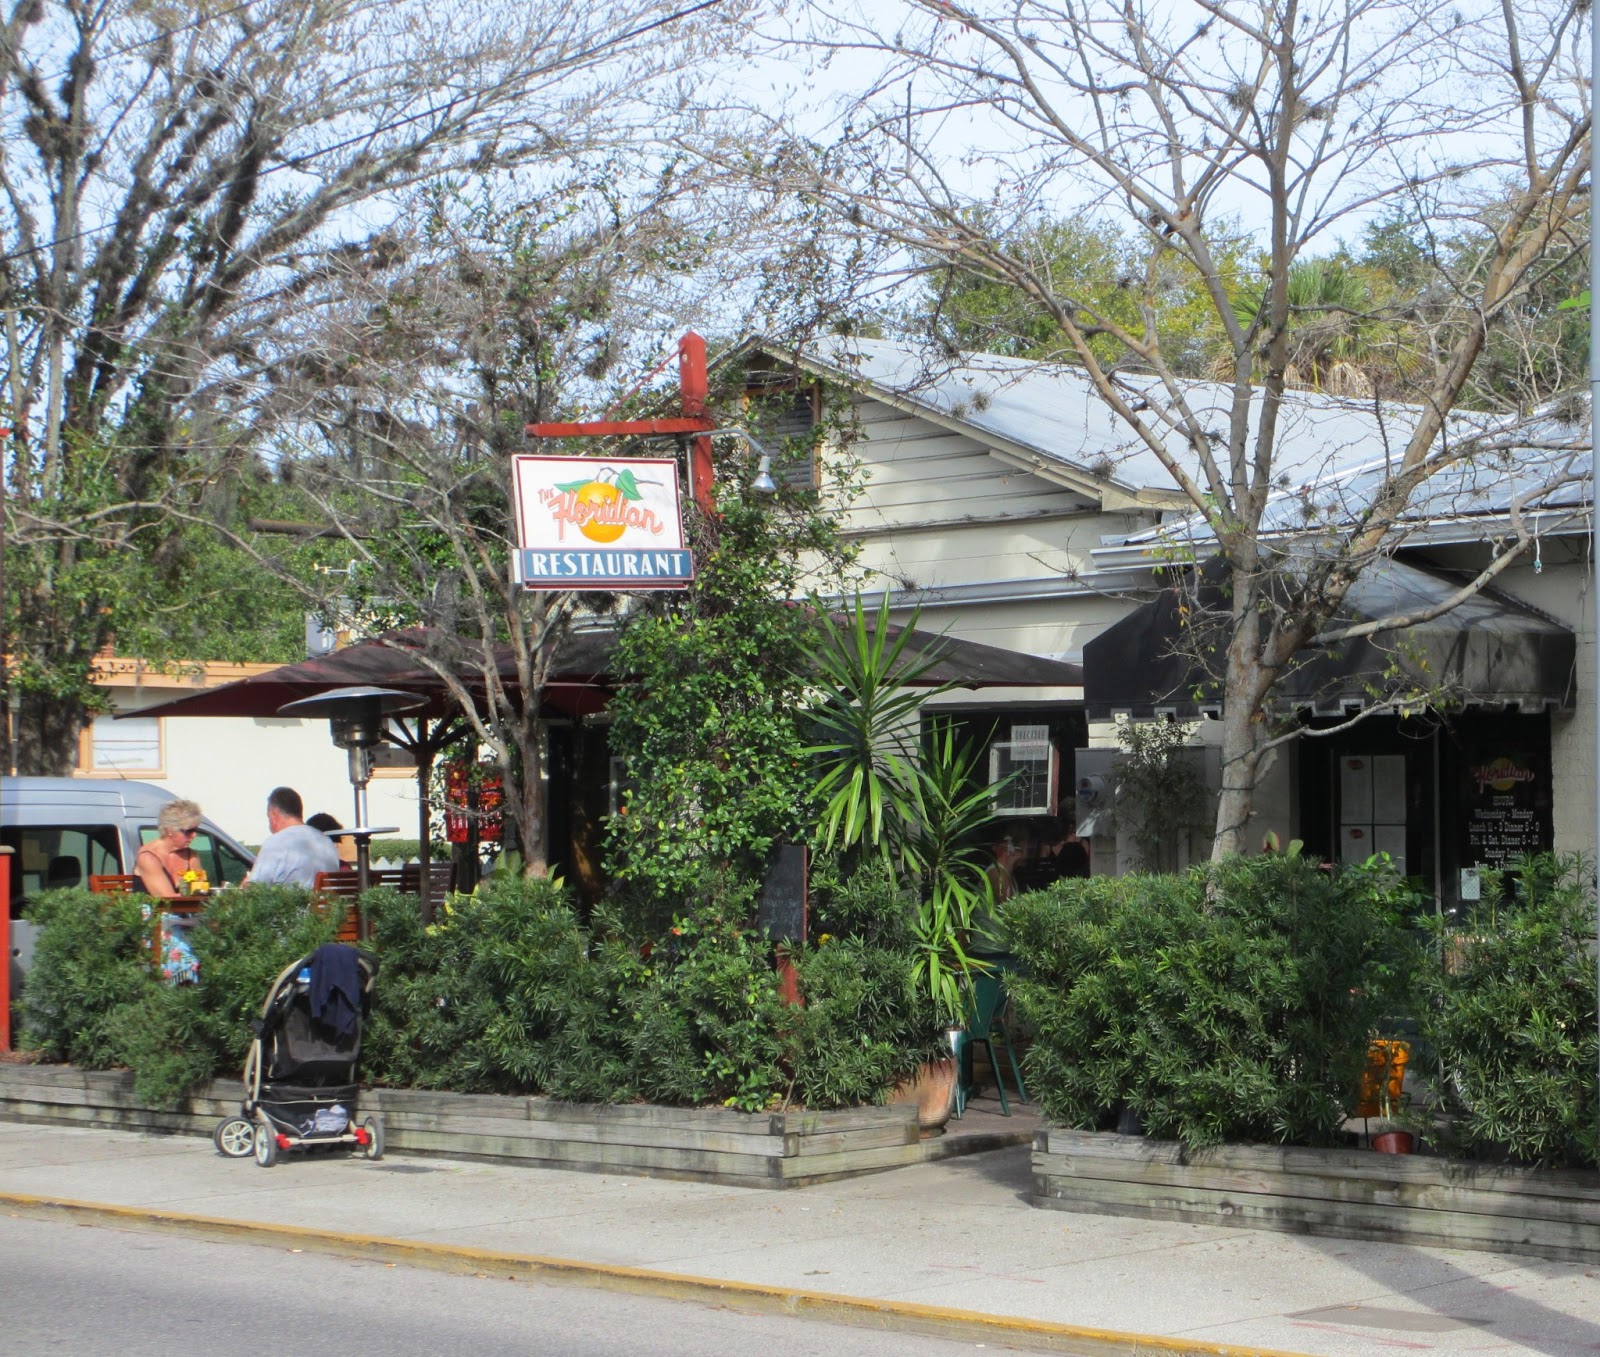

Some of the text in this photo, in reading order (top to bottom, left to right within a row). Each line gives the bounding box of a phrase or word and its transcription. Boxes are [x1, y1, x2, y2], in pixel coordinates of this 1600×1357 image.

[538, 488, 664, 542] THE Floridian
[532, 553, 683, 576] RESTAURANT
[1493, 795, 1514, 806] HOURS
[1475, 808, 1506, 822] Wednesday
[1511, 808, 1534, 822] Monday
[1469, 821, 1486, 832] Lunch
[1498, 821, 1503, 832] 3
[1504, 821, 1523, 832] Dinner
[1525, 821, 1529, 832] 5
[1482, 834, 1487, 845] &
[1501, 834, 1520, 845] Dinner
[1522, 834, 1526, 845] 5
[1532, 834, 1539, 845] 10
[1484, 847, 1505, 861] Sunday
